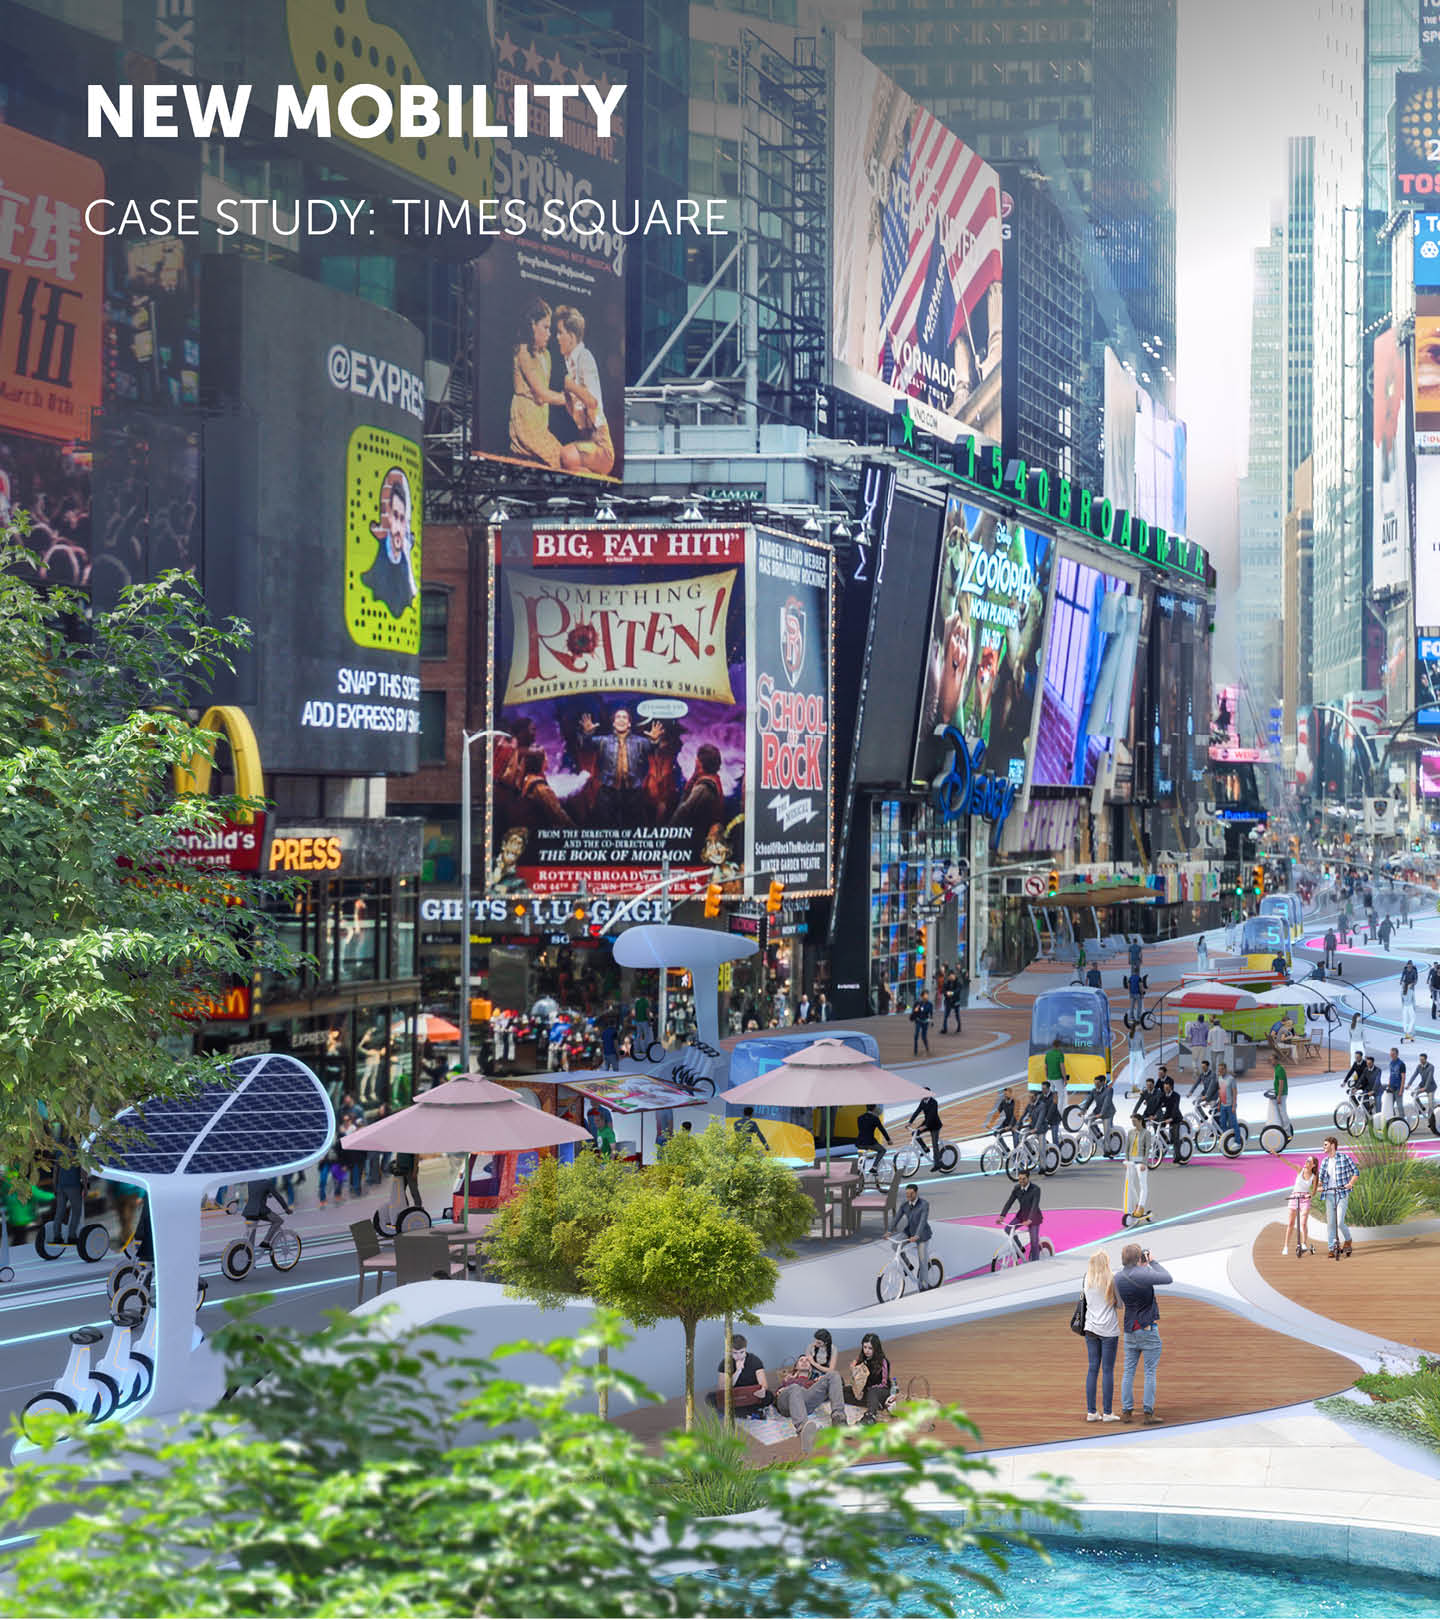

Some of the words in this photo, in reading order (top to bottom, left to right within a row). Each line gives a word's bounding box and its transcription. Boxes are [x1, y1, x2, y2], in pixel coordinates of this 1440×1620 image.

[966, 434, 1049, 509] 1540
[710, 487, 759, 500] LAMAR
[536, 534, 593, 559] BIG,
[603, 534, 658, 557] FAT
[960, 540, 1032, 604] ZOOTOPIA
[538, 582, 703, 606] SOMETHING
[337, 667, 377, 696] SNAP
[378, 672, 401, 698] THIS
[301, 701, 335, 728] ADD
[336, 702, 395, 732] EXPRESS
[757, 672, 828, 735] SCHOOL
[761, 732, 824, 791] ROCK
[538, 829, 560, 839] FROM
[563, 829, 578, 838] THE
[581, 829, 619, 838] DIRECTOR
[633, 826, 693, 839] ALADDIN
[564, 840, 581, 849] AND
[584, 840, 599, 848] THE
[269, 837, 343, 872] PRESS
[539, 850, 567, 862] THE
[570, 850, 607, 862] BOOK
[611, 850, 629, 861] OF
[631, 850, 693, 862] MORMON
[1074, 1009, 1094, 1038] 5
[1074, 1039, 1094, 1048] line
